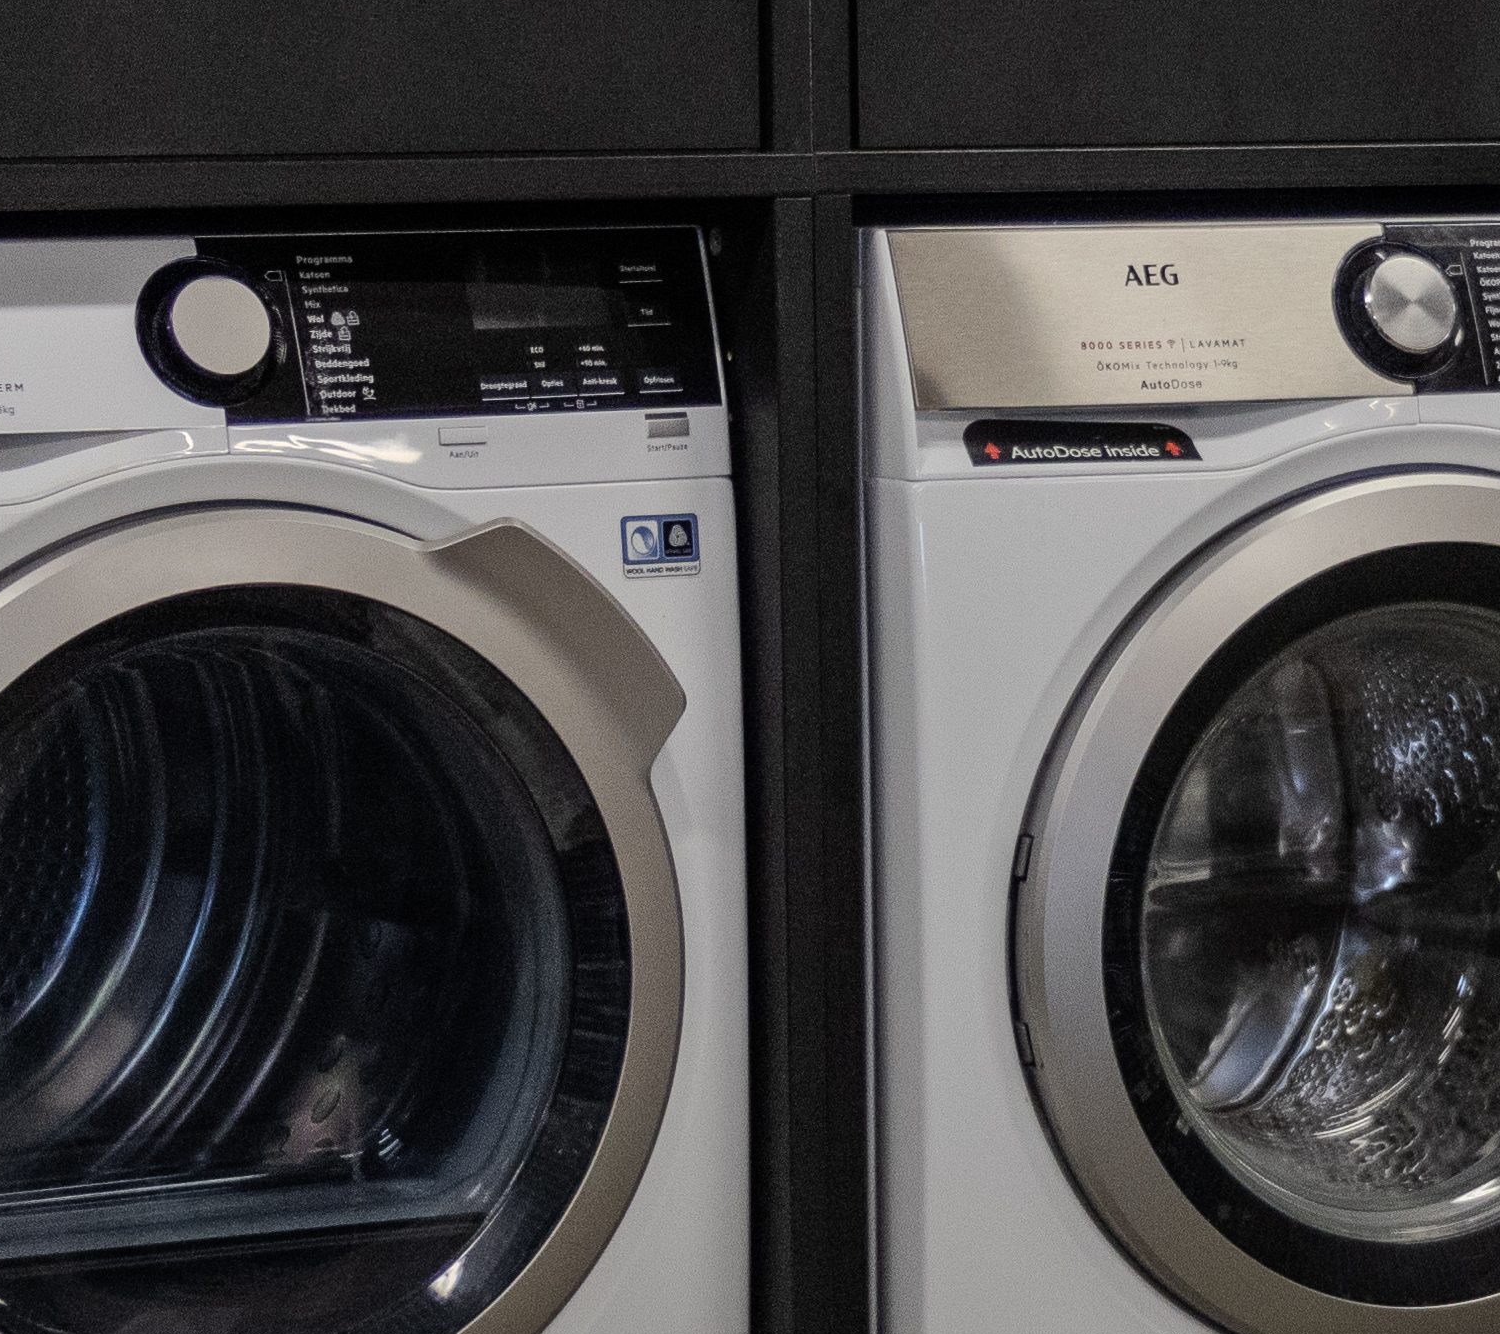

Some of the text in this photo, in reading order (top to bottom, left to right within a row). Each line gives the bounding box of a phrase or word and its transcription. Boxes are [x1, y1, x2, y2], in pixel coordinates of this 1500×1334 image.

[296, 255, 353, 266] Programma
[299, 271, 331, 279] Katoen
[1125, 264, 1179, 287] AEG
[302, 285, 349, 295] Synthetica
[304, 300, 321, 309] Mix
[307, 314, 325, 323] Wol
[310, 330, 333, 340] Zijde
[312, 344, 352, 354] Strijkvrij
[1080, 339, 1245, 350] 8000 SERIES LAVAMAT
[530, 346, 544, 354] ECO
[315, 358, 370, 369] Beddengoed
[1097, 360, 1140, 371] ÖKOMix
[1146, 360, 1208, 371] Technology
[317, 374, 374, 384] Sportkleding
[480, 380, 528, 390] Droogtegraad
[1141, 379, 1202, 390] AutoDose
[320, 390, 357, 399] Outdoor
[322, 405, 356, 414] Dekbed
[449, 450, 479, 459] Aan/Uit
[1011, 444, 1160, 459] AutoDose inside
